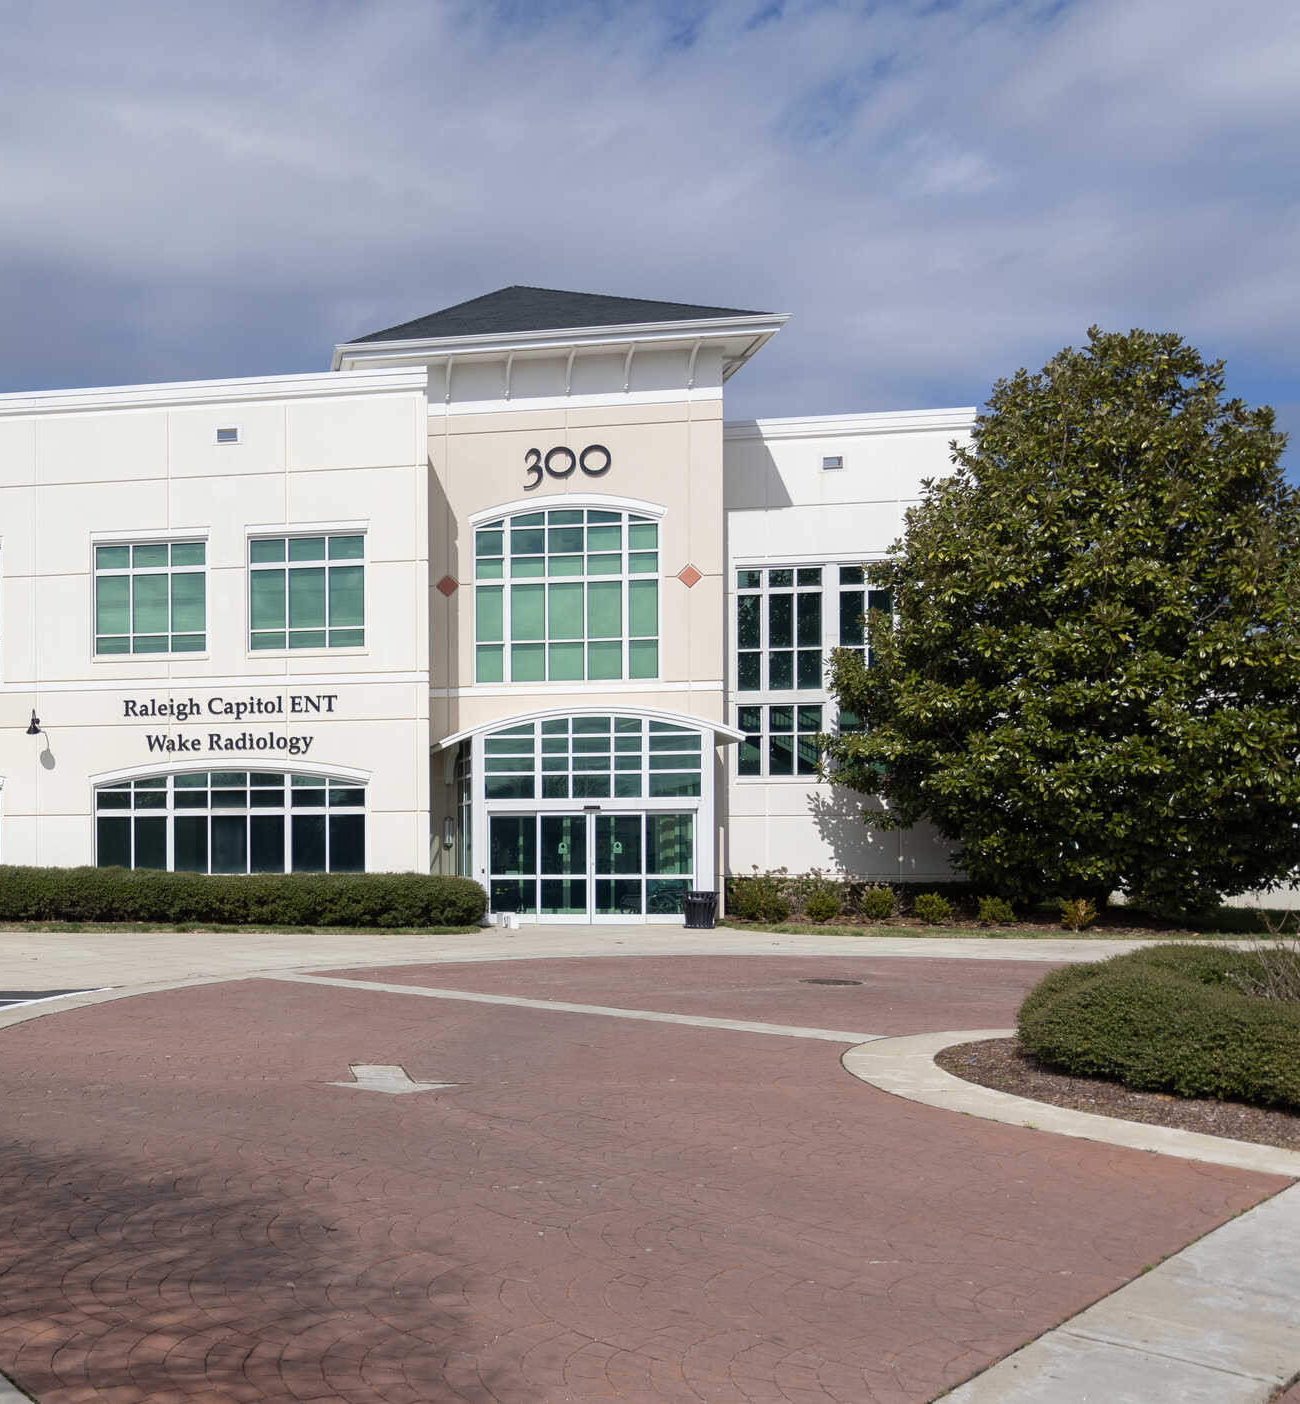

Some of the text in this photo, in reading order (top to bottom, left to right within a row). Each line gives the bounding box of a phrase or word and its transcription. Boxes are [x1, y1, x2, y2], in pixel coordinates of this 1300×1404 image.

[523, 444, 612, 491] 300
[123, 695, 338, 721] Raleigh Capitol ENT
[145, 732, 313, 755] Wake Radiology
